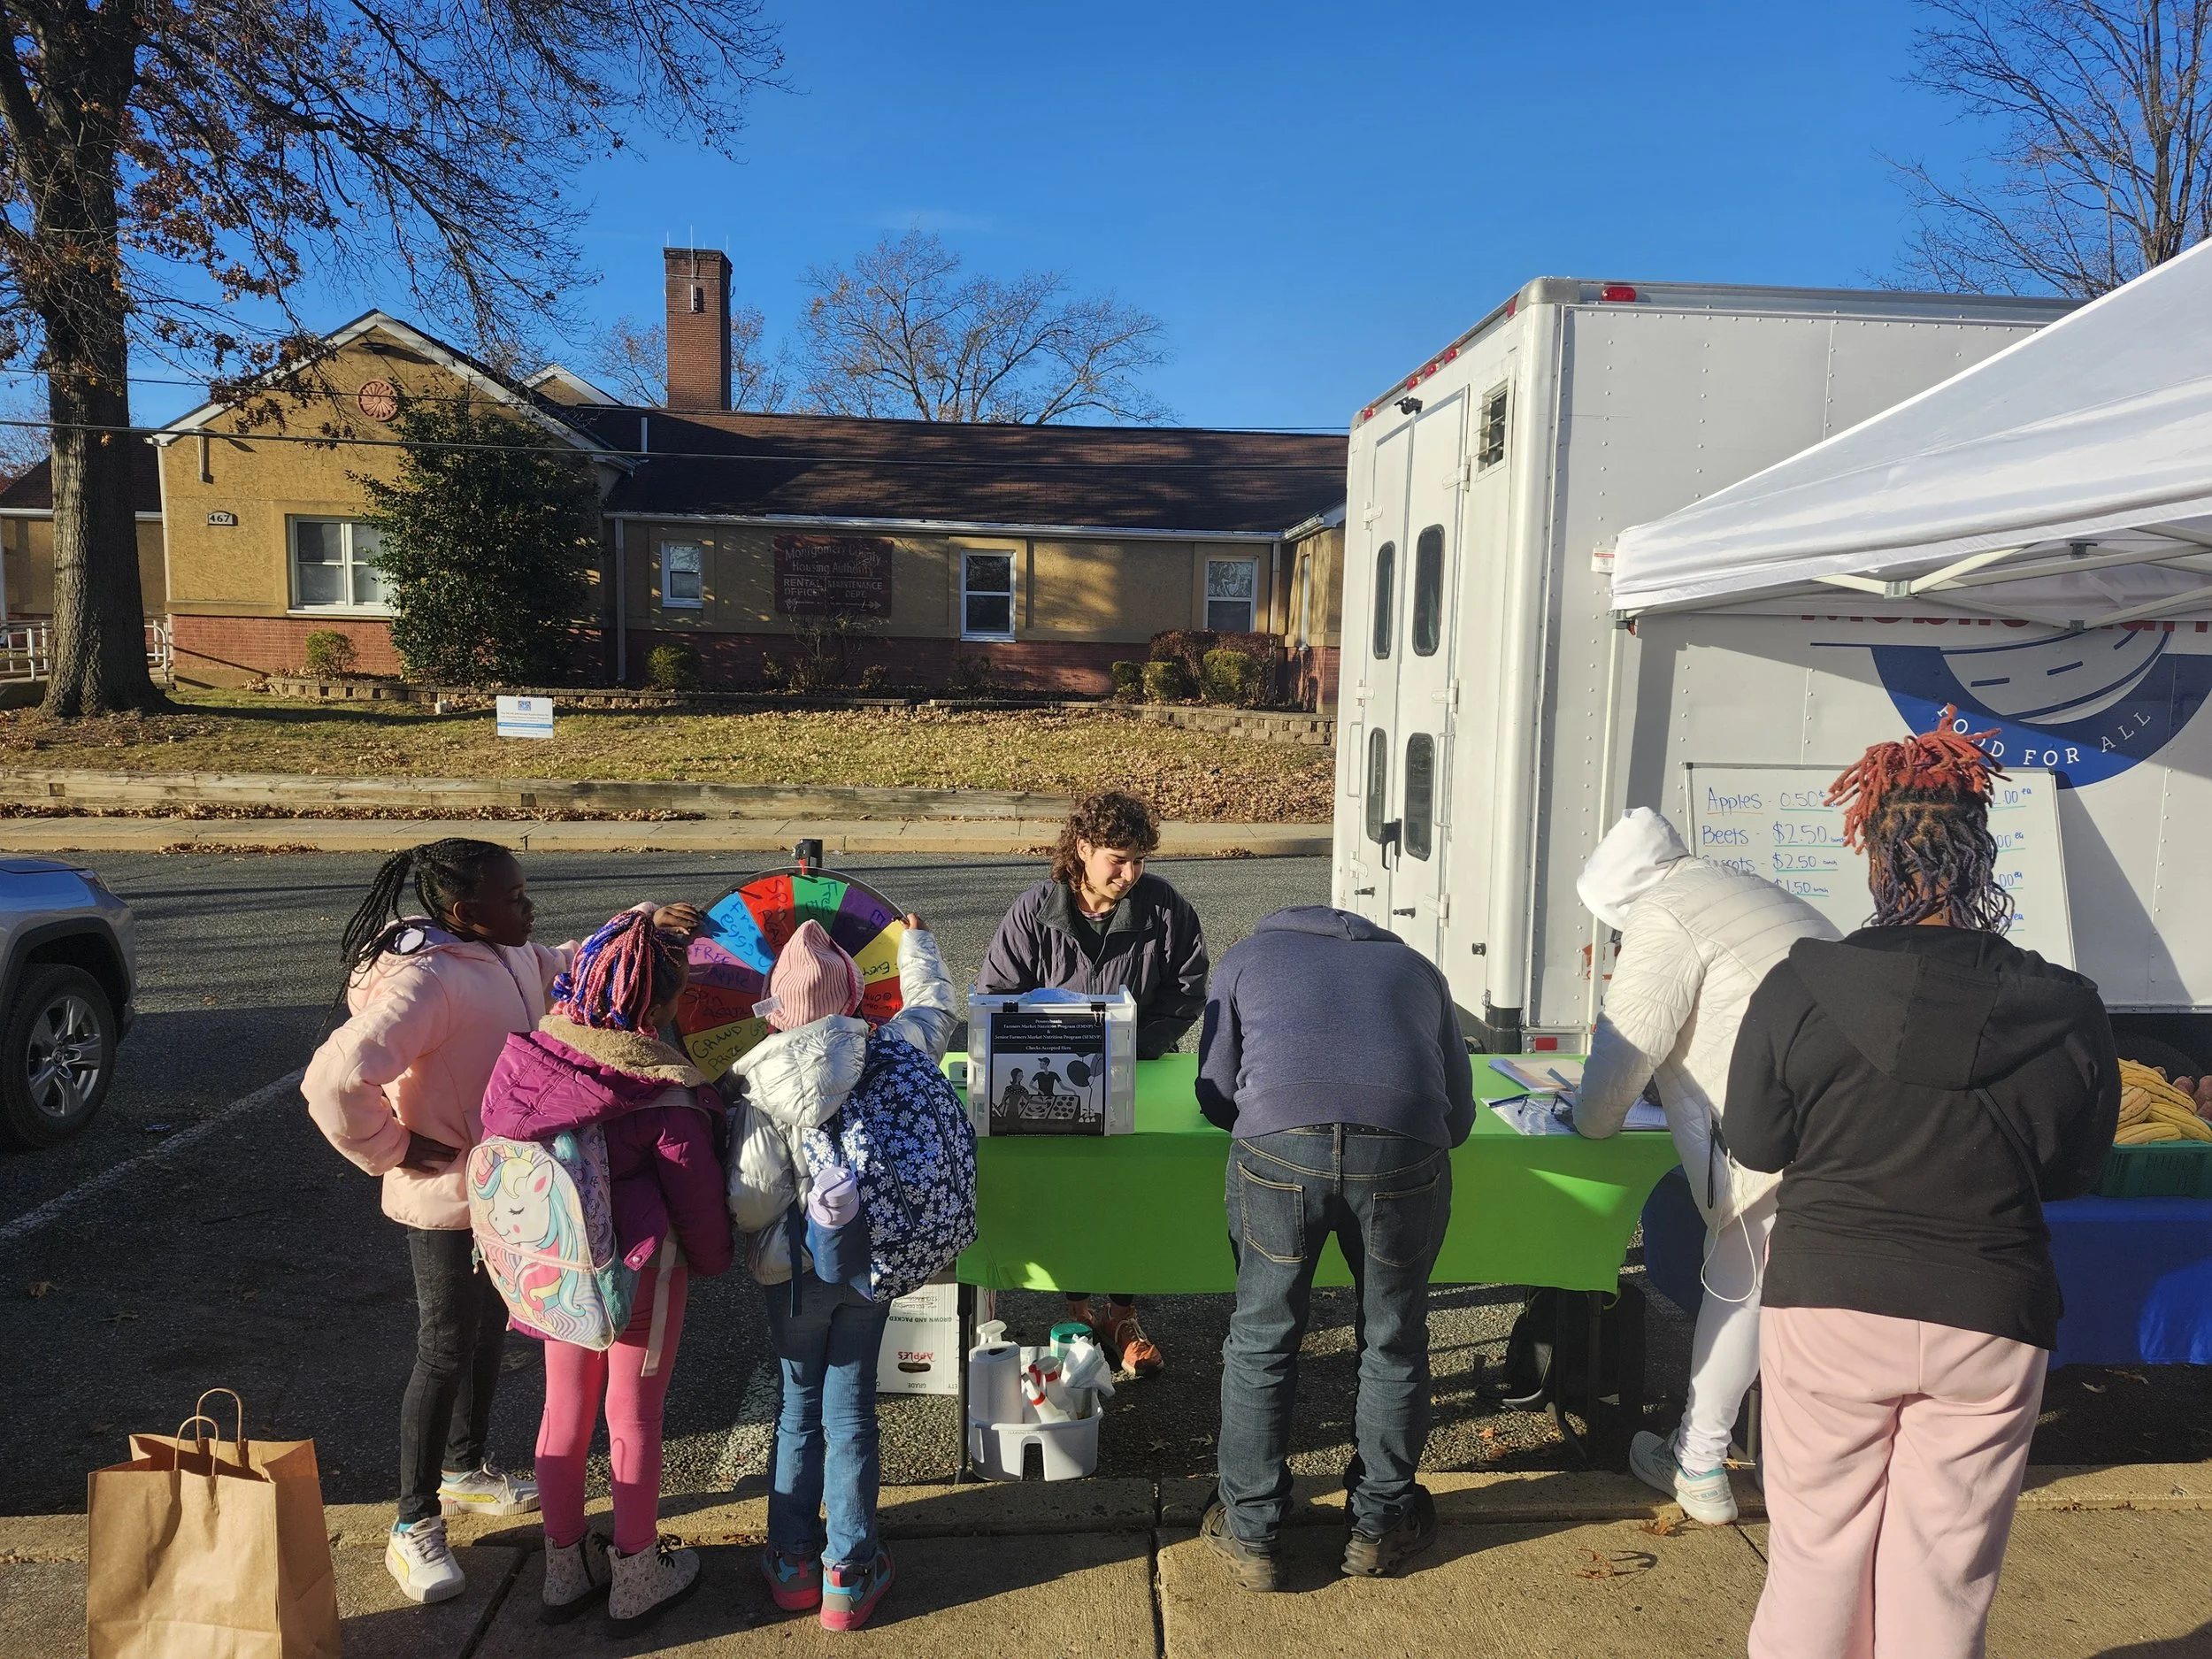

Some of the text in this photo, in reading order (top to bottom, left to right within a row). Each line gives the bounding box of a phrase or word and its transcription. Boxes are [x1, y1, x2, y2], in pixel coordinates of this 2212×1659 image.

[793, 561, 830, 575] Housing
[783, 579, 823, 588] RENTAL
[828, 580, 883, 590] MAINTENANCE
[2023, 748, 2080, 767] FOR
[2101, 710, 2152, 754] ALL
[1708, 787, 1763, 816] Apples
[1702, 825, 1749, 846] Beets
[1772, 821, 1827, 845] $2.50
[1772, 852, 1816, 870] $2.50
[694, 943, 731, 965] FREE
[692, 1025, 742, 1059] GRAND
[897, 1351, 933, 1361] APPLES
